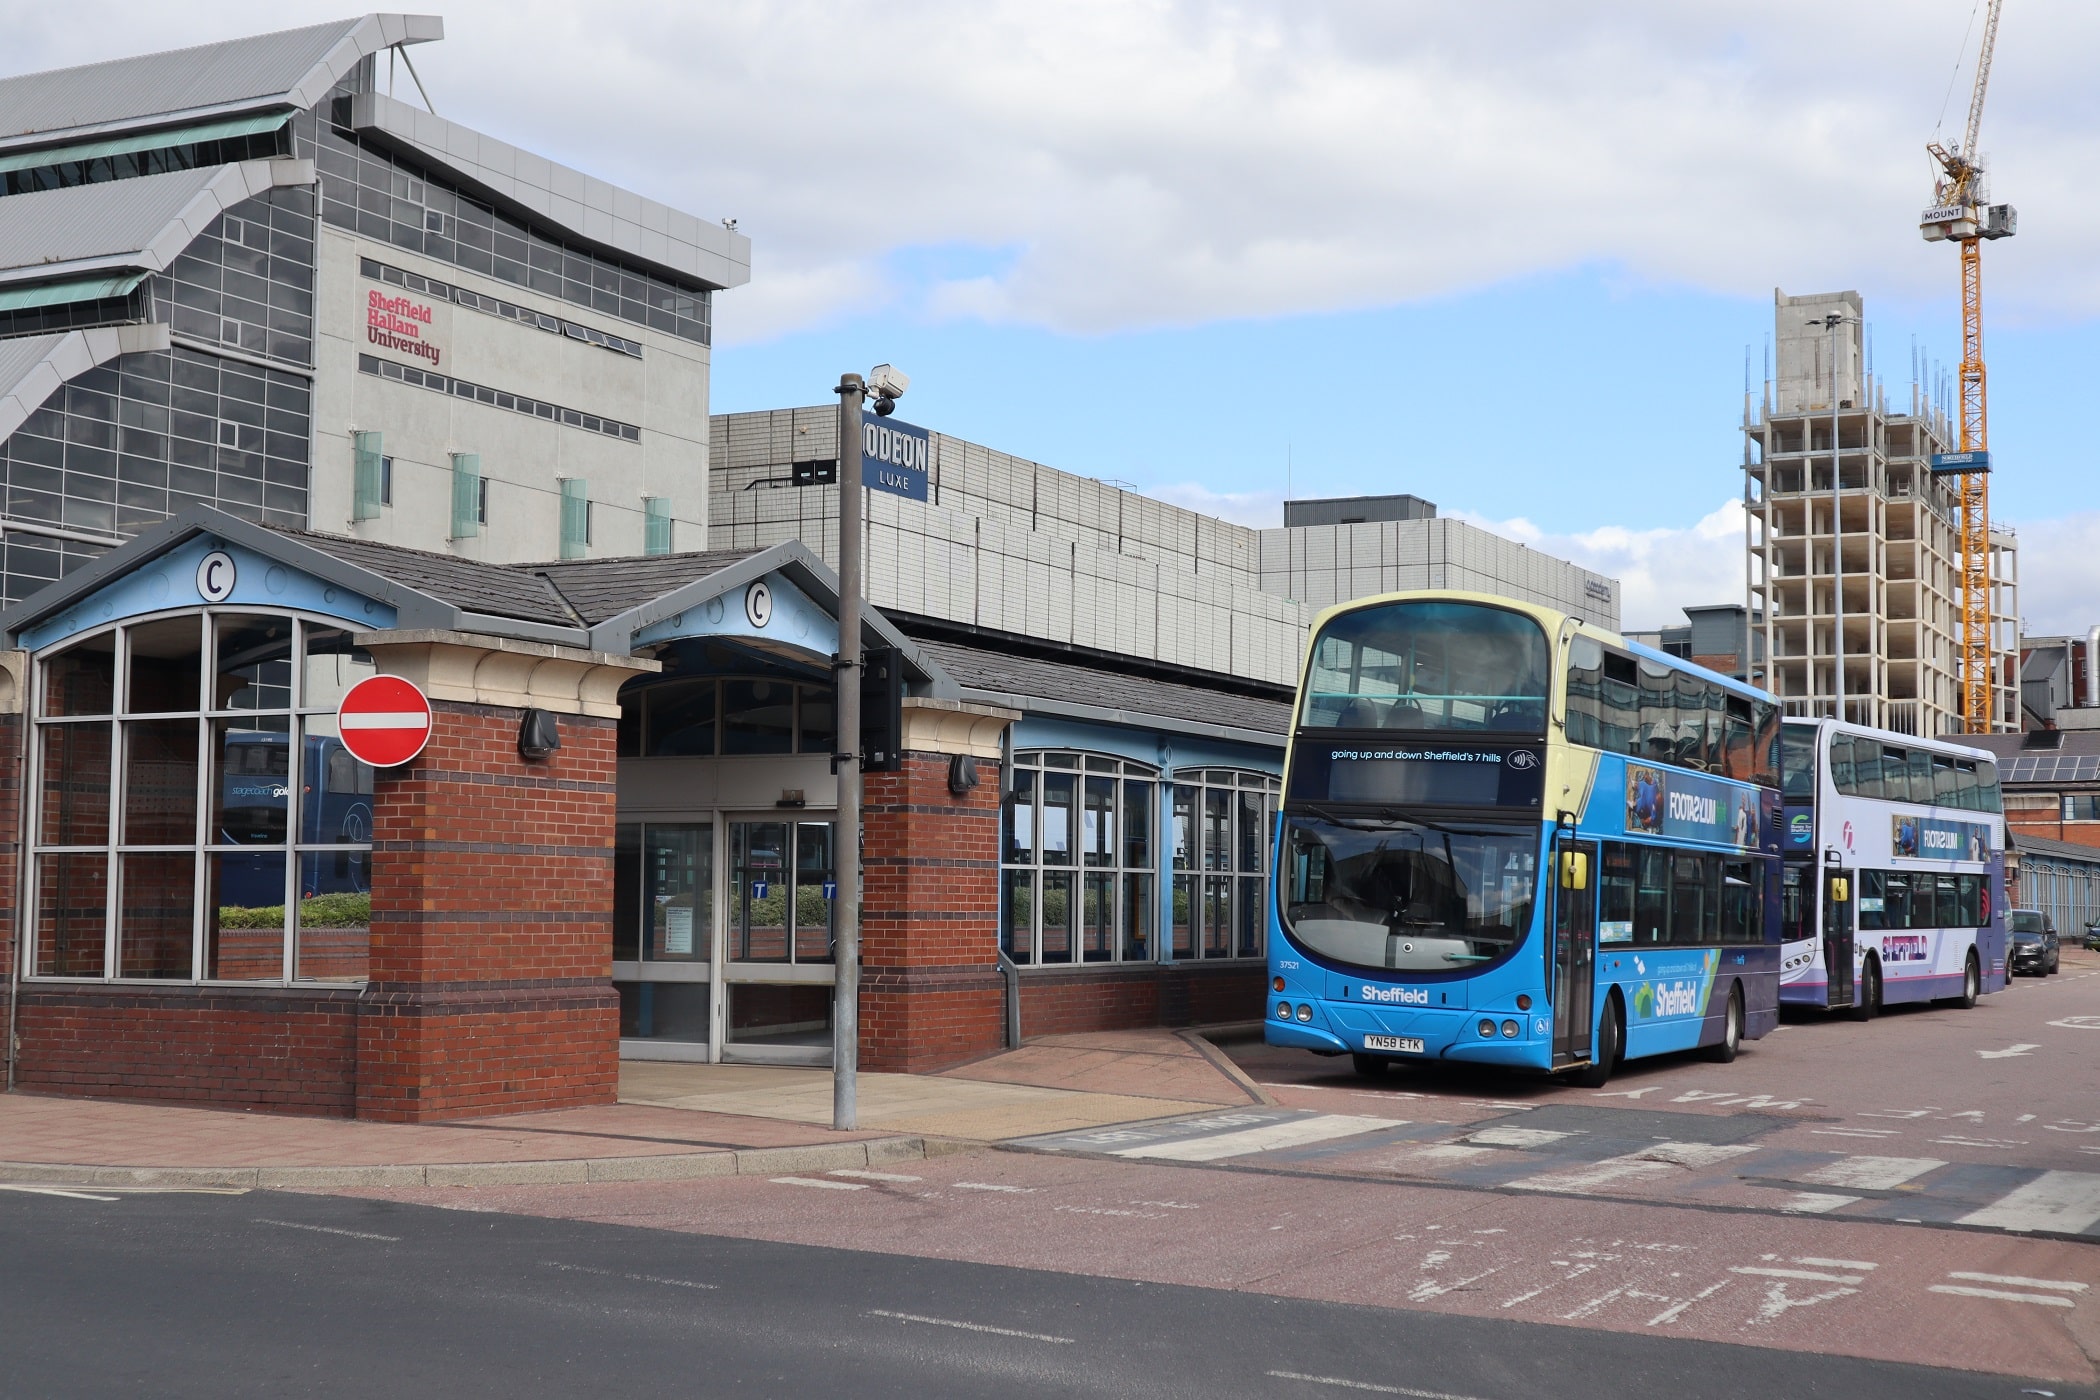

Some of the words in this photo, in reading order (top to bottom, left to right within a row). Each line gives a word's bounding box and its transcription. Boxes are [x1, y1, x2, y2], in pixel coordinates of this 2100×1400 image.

[1924, 208, 1960, 220] MOUNT
[368, 289, 432, 325] Sheffield
[367, 307, 419, 338] Hallam
[367, 325, 441, 366] University
[863, 422, 927, 472] ODEON
[879, 470, 909, 491] LUXE
[206, 560, 223, 594] C
[753, 589, 765, 620] C
[1331, 749, 1358, 760] going
[1360, 751, 1373, 760] up
[1374, 750, 1394, 760] and
[1395, 751, 1422, 760] down
[1424, 751, 1474, 761] Sheffield's
[1475, 753, 1481, 762] 7
[1482, 753, 1502, 763] hills
[232, 786, 273, 797] stagecoach
[1669, 791, 1716, 824] FOOTASYLUM
[754, 883, 766, 899] T
[824, 883, 836, 899] T
[1279, 960, 1299, 970] 37521
[1362, 985, 1428, 1004] Sheffield
[1656, 981, 1697, 1017] Sheffield
[1369, 1035, 1397, 1048] YN58
[1399, 1038, 1421, 1050] ETK
